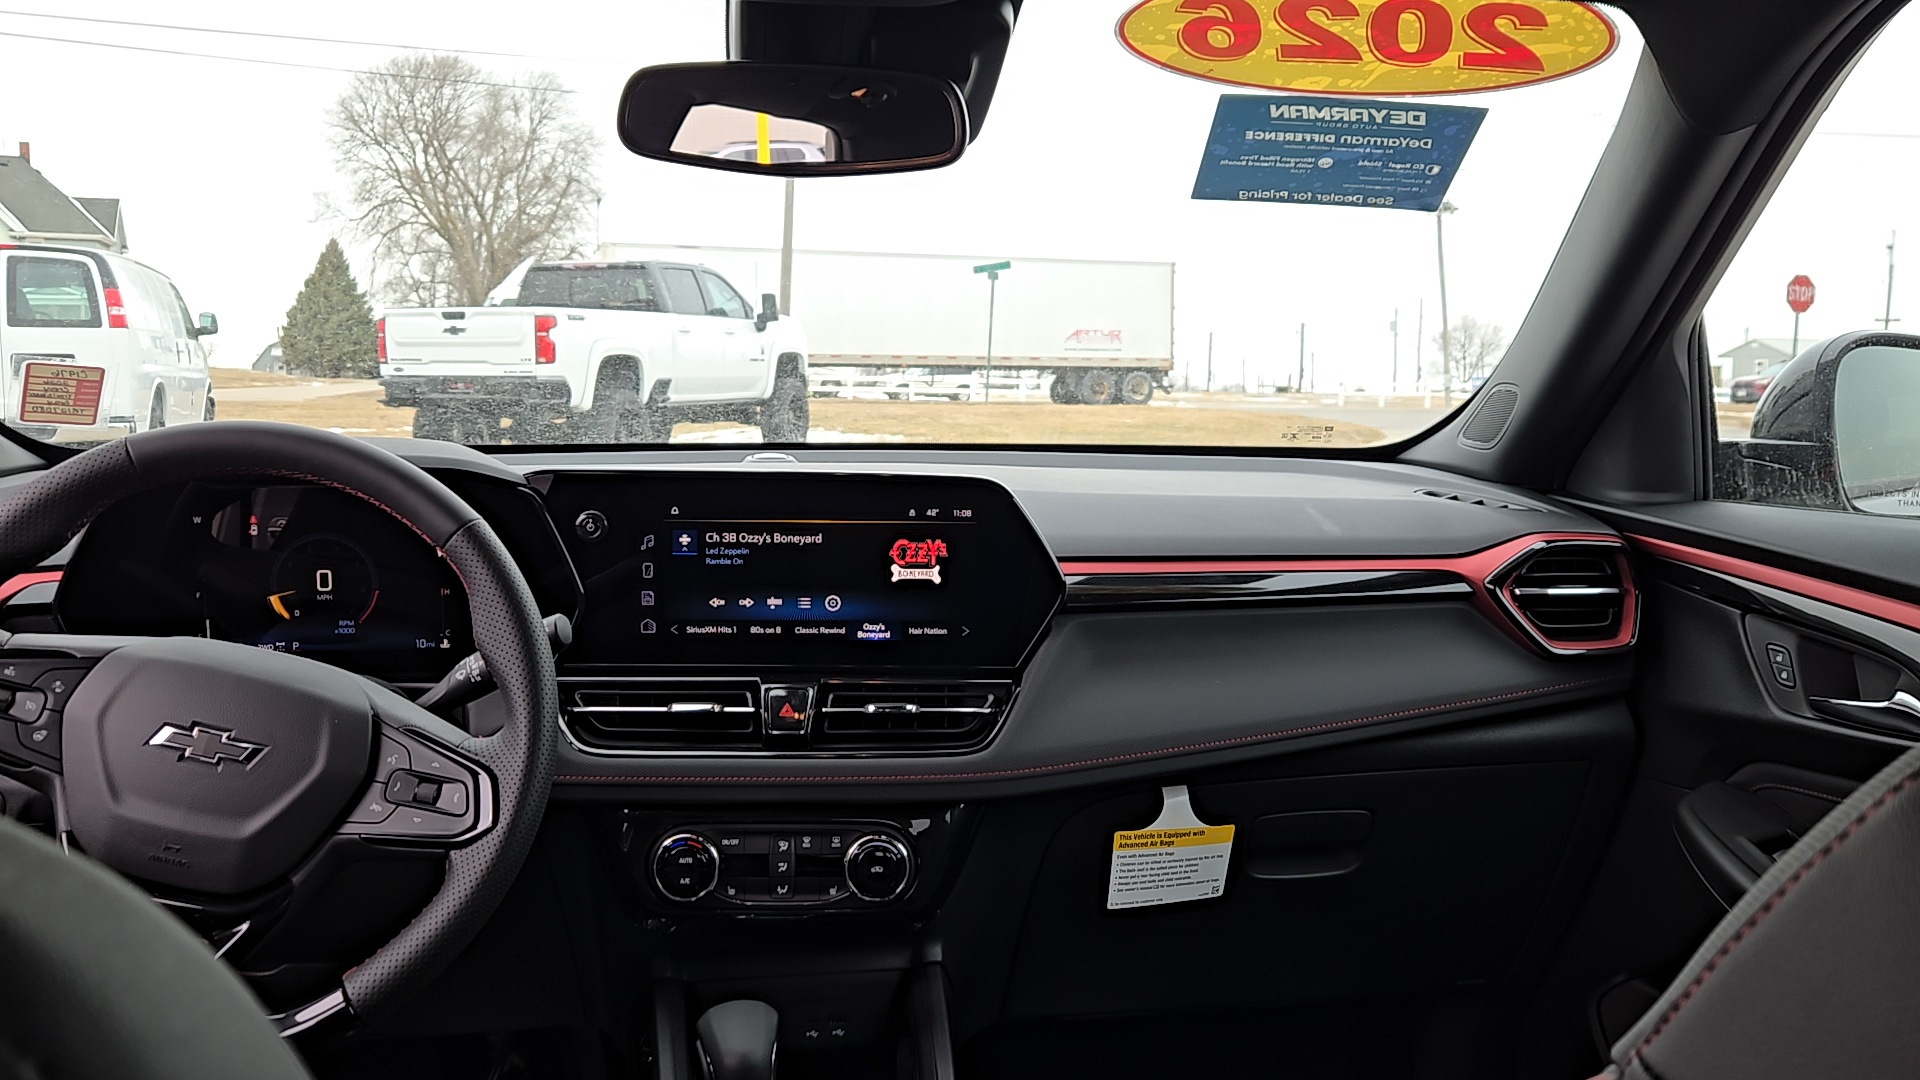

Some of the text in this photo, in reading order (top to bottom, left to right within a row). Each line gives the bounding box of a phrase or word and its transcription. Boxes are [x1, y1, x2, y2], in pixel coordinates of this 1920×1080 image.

[1788, 284, 1815, 301] STOP
[953, 509, 973, 517] 11:08
[705, 532, 720, 543] Ch
[739, 532, 772, 545] Ozzy's
[773, 532, 823, 546] Boneyard
[705, 547, 750, 556] Led Zeppelin
[705, 557, 744, 565] Ramble On
[897, 569, 934, 578] BONEYARD
[316, 569, 333, 591] 0
[338, 619, 355, 627] RPM
[862, 623, 885, 631] Ozzy's
[686, 626, 717, 634] SiriusXM
[717, 626, 732, 634] Hits
[750, 626, 764, 634] 80s
[795, 626, 846, 634] Classic Rewind
[908, 627, 948, 635] Hair Nation
[857, 631, 891, 639] Boneyard
[292, 641, 300, 650] P
[1133, 832, 1156, 840] Vehicle
[1164, 830, 1191, 839] Equipped
[1192, 829, 1206, 837] with
[1118, 839, 1175, 849] Advanced Air Bags
[680, 877, 691, 885] A/C
